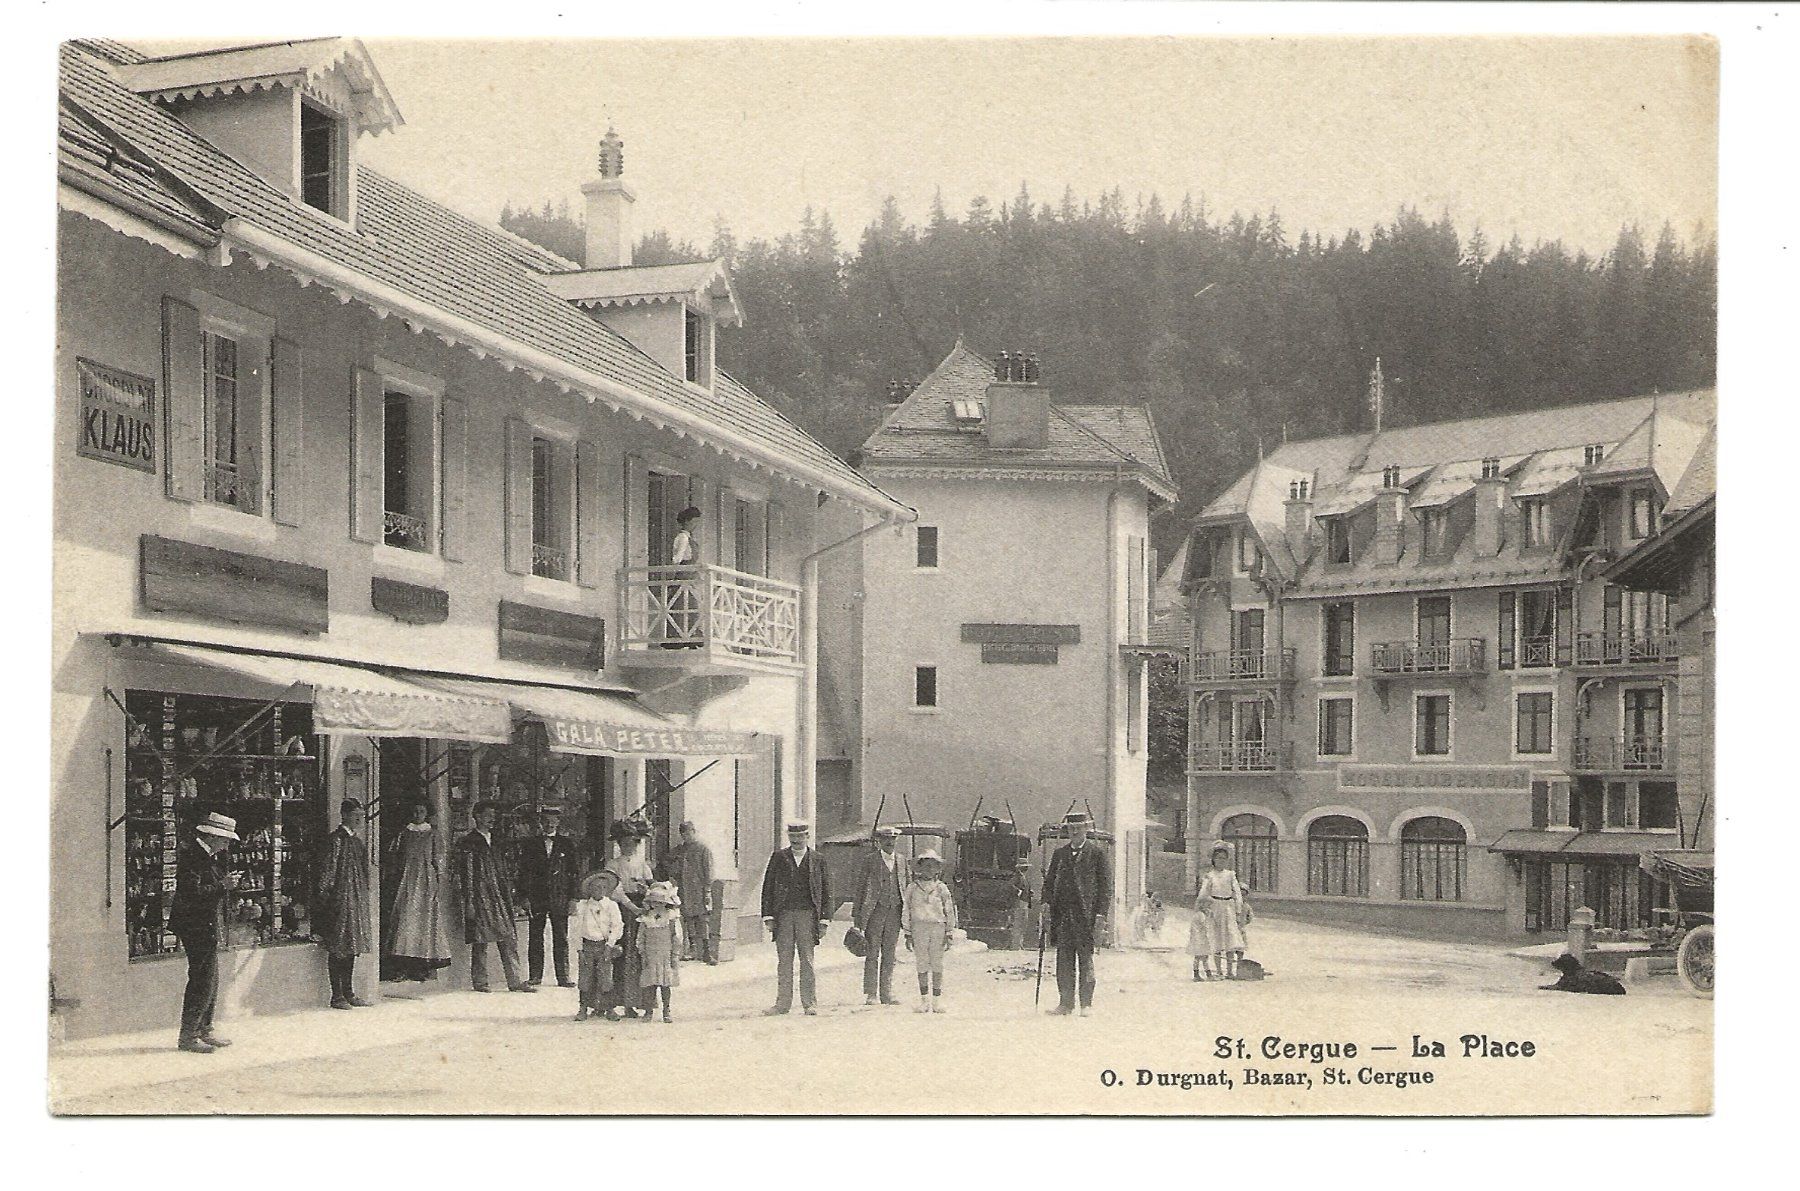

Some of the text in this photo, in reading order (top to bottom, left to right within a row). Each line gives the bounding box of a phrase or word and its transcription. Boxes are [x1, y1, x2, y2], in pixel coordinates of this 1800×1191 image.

[82, 406, 153, 461] KLAUS
[555, 721, 608, 748] GALA
[616, 730, 688, 751] PETER
